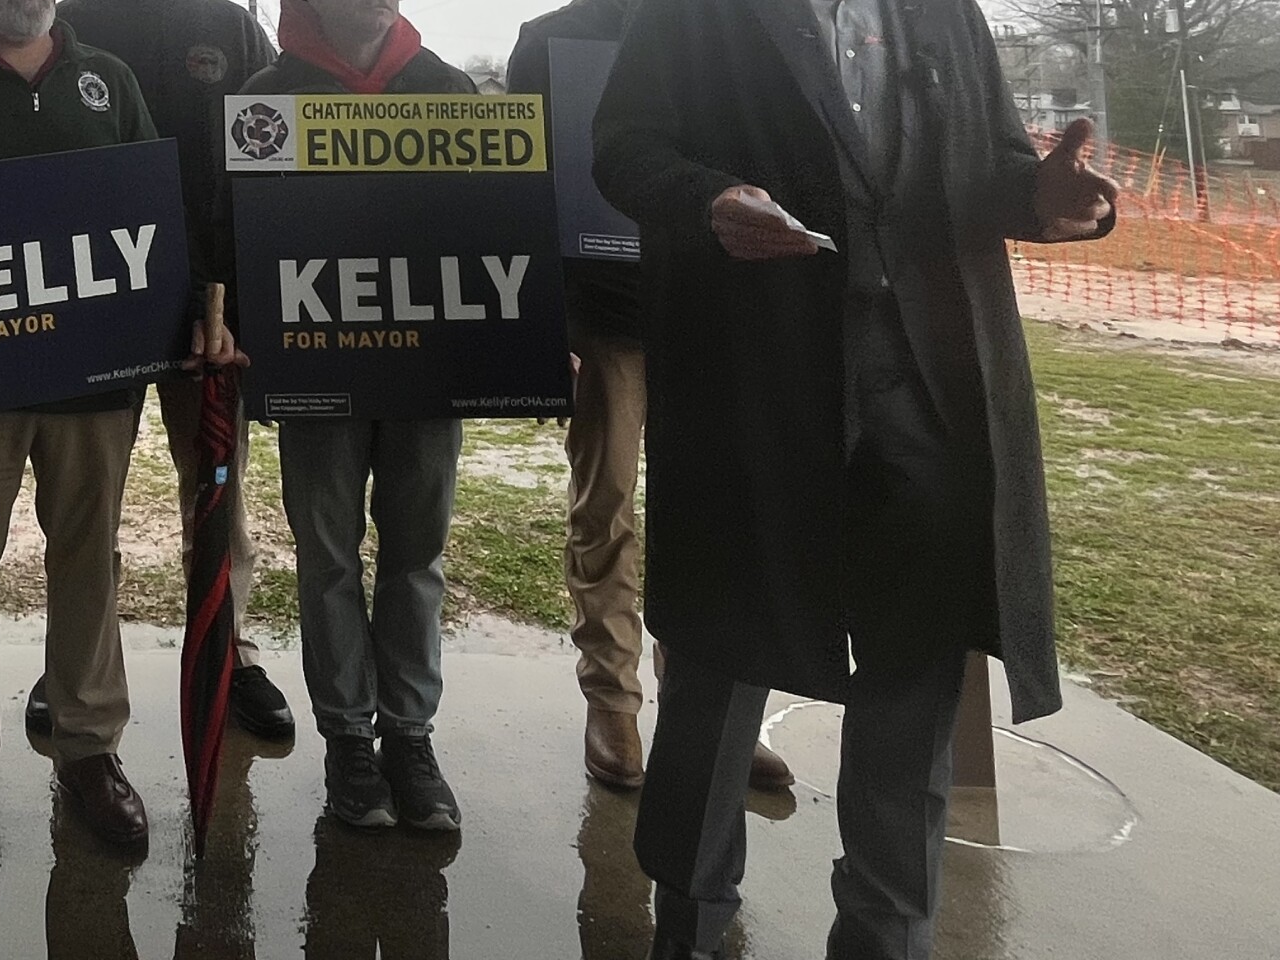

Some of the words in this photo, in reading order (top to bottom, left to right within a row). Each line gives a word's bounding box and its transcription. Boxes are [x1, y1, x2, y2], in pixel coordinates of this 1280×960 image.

[302, 102, 421, 120] CHATTANOOGA
[426, 102, 536, 120] FIREFIGHTERS
[306, 128, 533, 166] ENDORSED
[278, 255, 531, 323] KELLY
[283, 331, 327, 349] FOR
[338, 330, 420, 348] MAYOR
[86, 360, 185, 384] www.KellyForCHA.co
[451, 396, 567, 410] www.KellyForCHA.com
